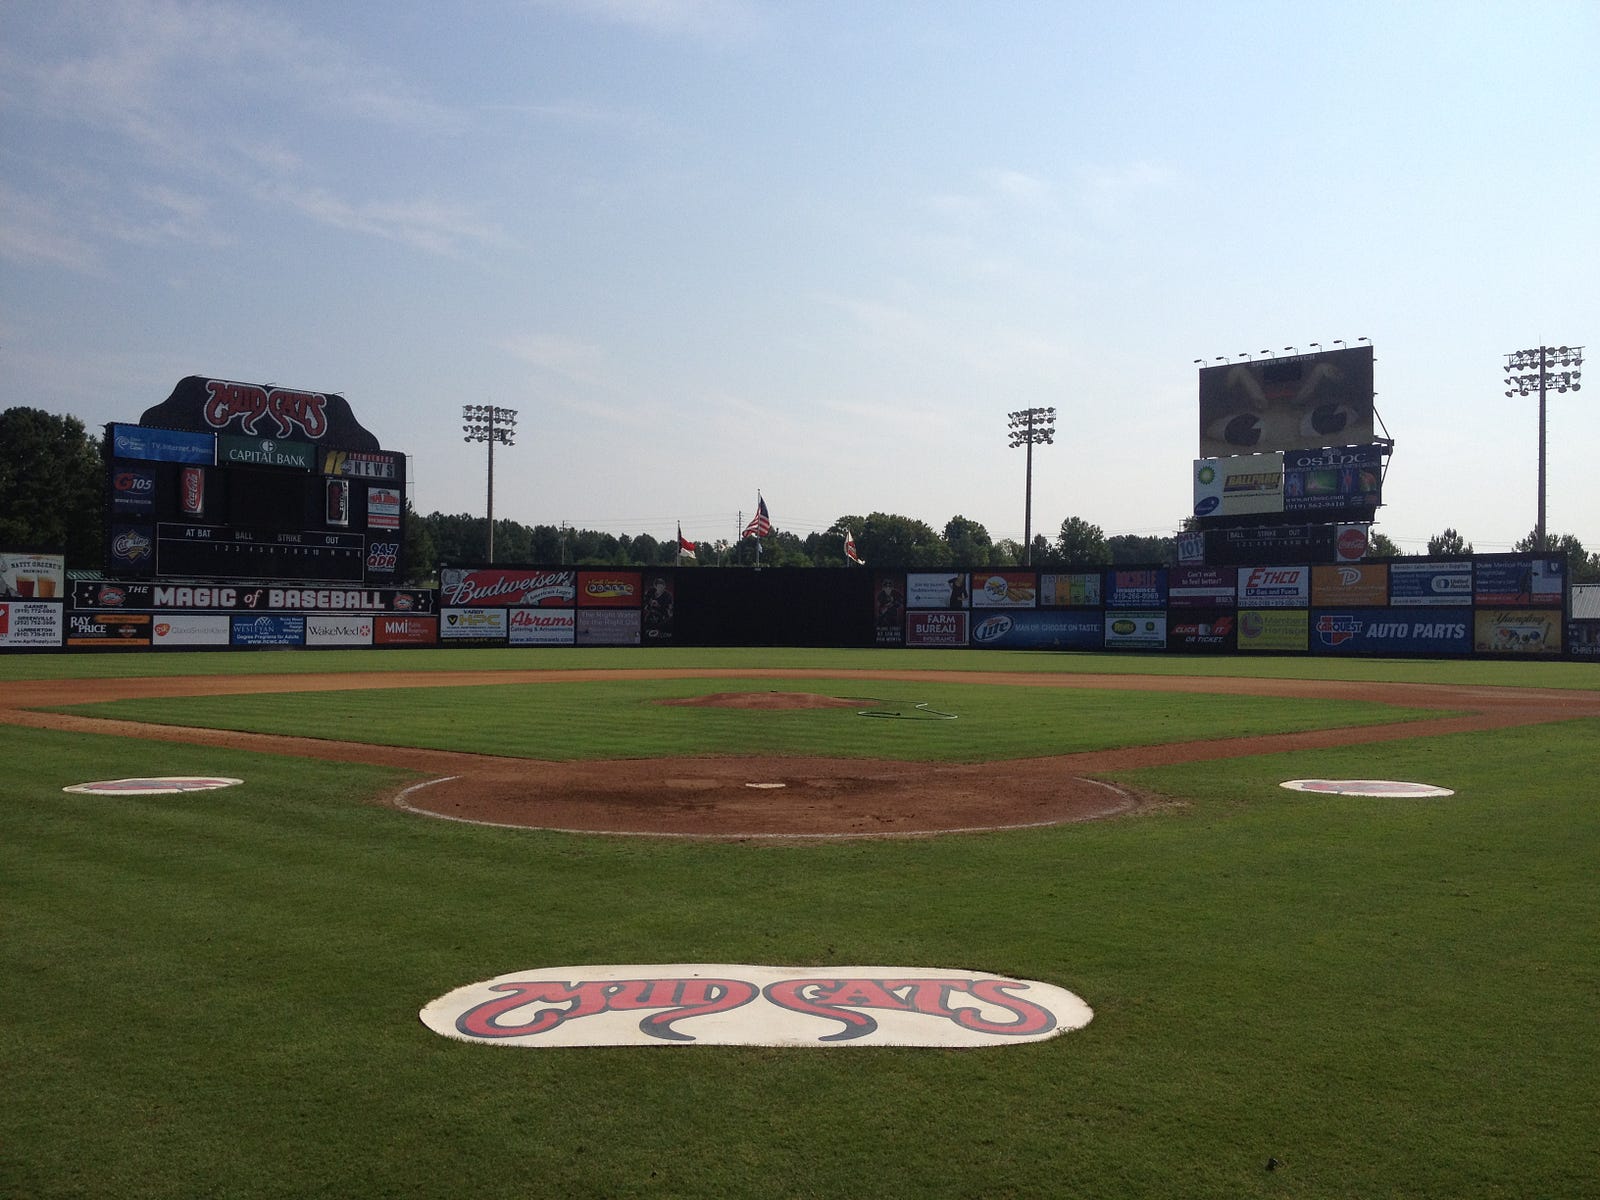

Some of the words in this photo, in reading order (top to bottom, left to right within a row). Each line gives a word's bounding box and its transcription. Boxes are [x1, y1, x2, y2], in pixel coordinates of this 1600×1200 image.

[204, 380, 268, 435] MUD
[268, 387, 327, 438] CATS
[229, 449, 274, 463] CAPITAL
[277, 453, 305, 466] BANK
[354, 461, 393, 477] NEWS
[186, 529, 195, 537] AT
[235, 531, 253, 540] BALL
[277, 533, 301, 543] STRIKE
[325, 536, 339, 544] OUT
[367, 554, 397, 568] QDR
[1246, 567, 1300, 588] ETHCO
[443, 570, 569, 605] Budweiser
[128, 586, 151, 594] THE
[154, 586, 237, 607] MAGIC
[243, 590, 262, 609] of
[268, 588, 385, 610] BASEBALL
[70, 616, 92, 628] RAY
[511, 610, 574, 627] Abrams
[927, 615, 956, 624] FARM
[78, 624, 107, 633] PRICE
[172, 625, 229, 635] GlaxoSmithKline
[233, 624, 275, 633] WESLEYAN
[308, 626, 360, 637] WakeMed
[916, 624, 958, 634] BUREAU
[1316, 621, 1363, 633] CARQUEST
[1366, 623, 1409, 639] AUTO
[1412, 623, 1467, 640] PARTS
[1571, 646, 1593, 655] CHRIS
[456, 978, 761, 1041] MUD
[762, 978, 1058, 1041] CATS
